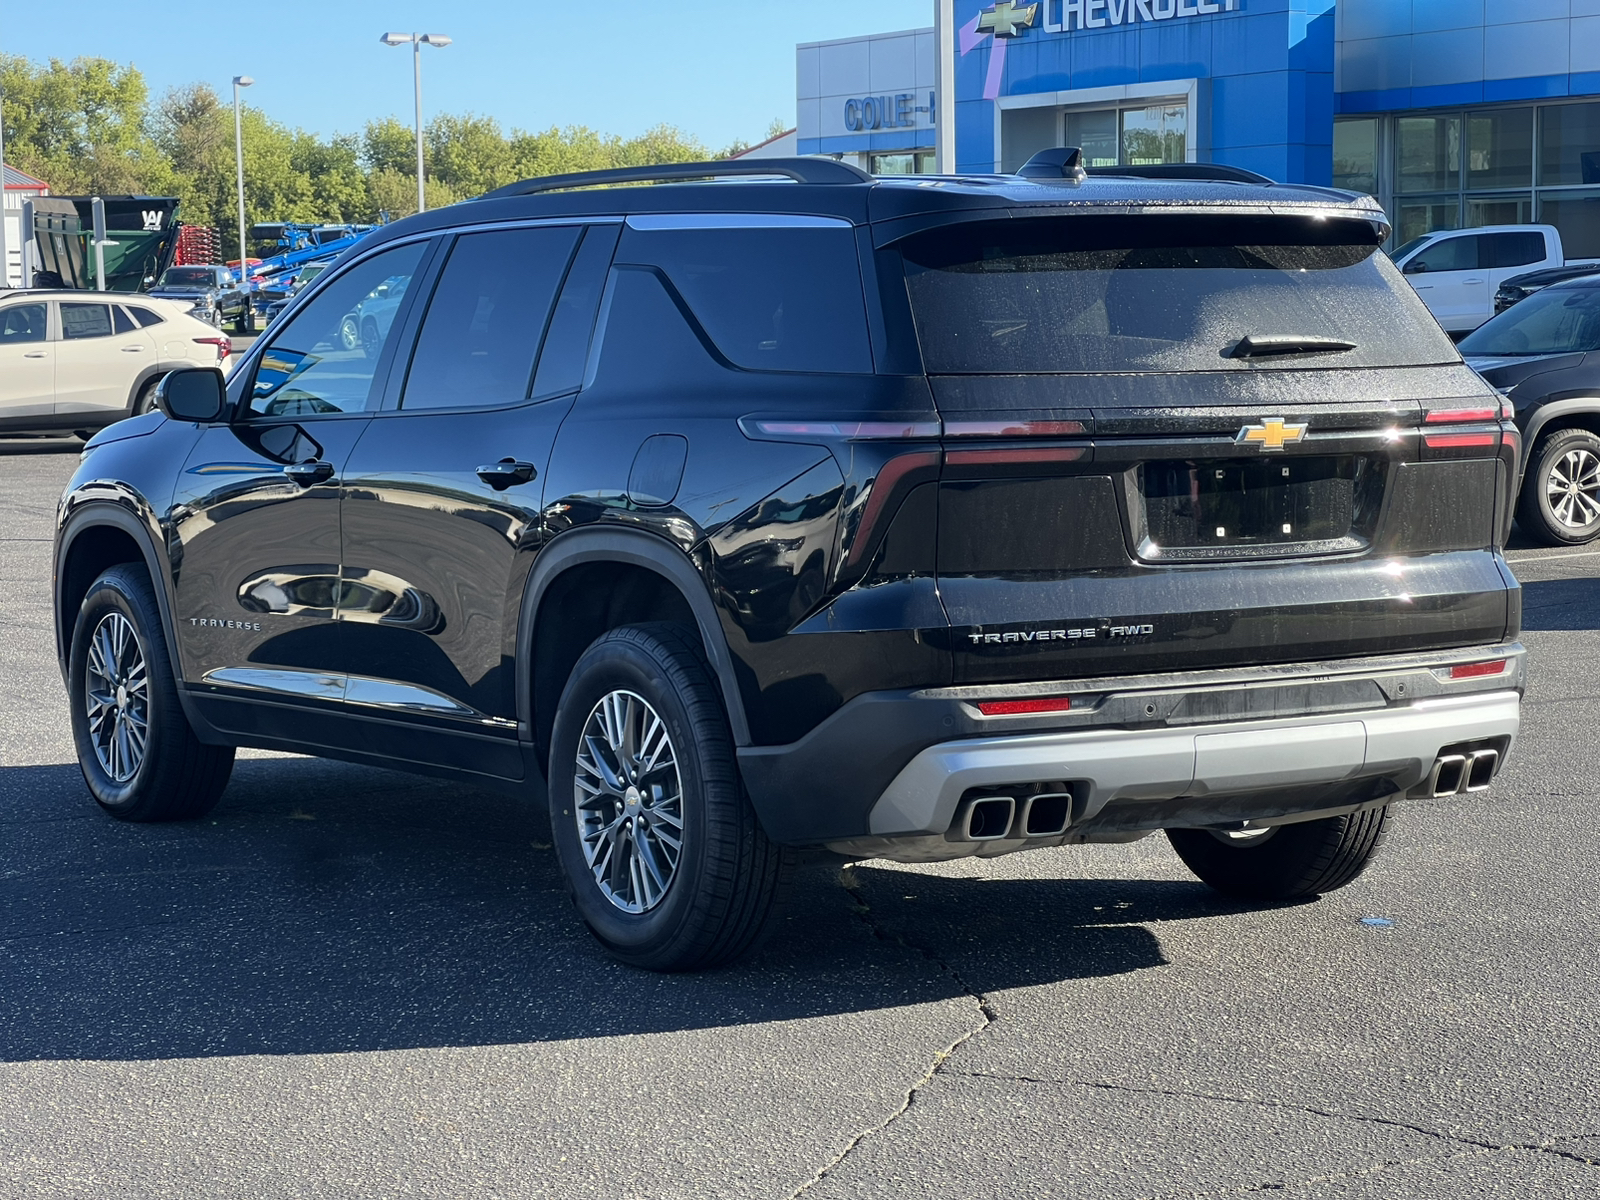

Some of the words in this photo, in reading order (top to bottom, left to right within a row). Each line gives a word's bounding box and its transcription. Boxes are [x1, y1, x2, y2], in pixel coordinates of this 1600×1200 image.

[1043, 0, 1234, 33] CHEVR
[190, 618, 261, 631] TRAVERSE
[968, 628, 1096, 644] TRAVERSE
[1109, 624, 1154, 637] AWD
